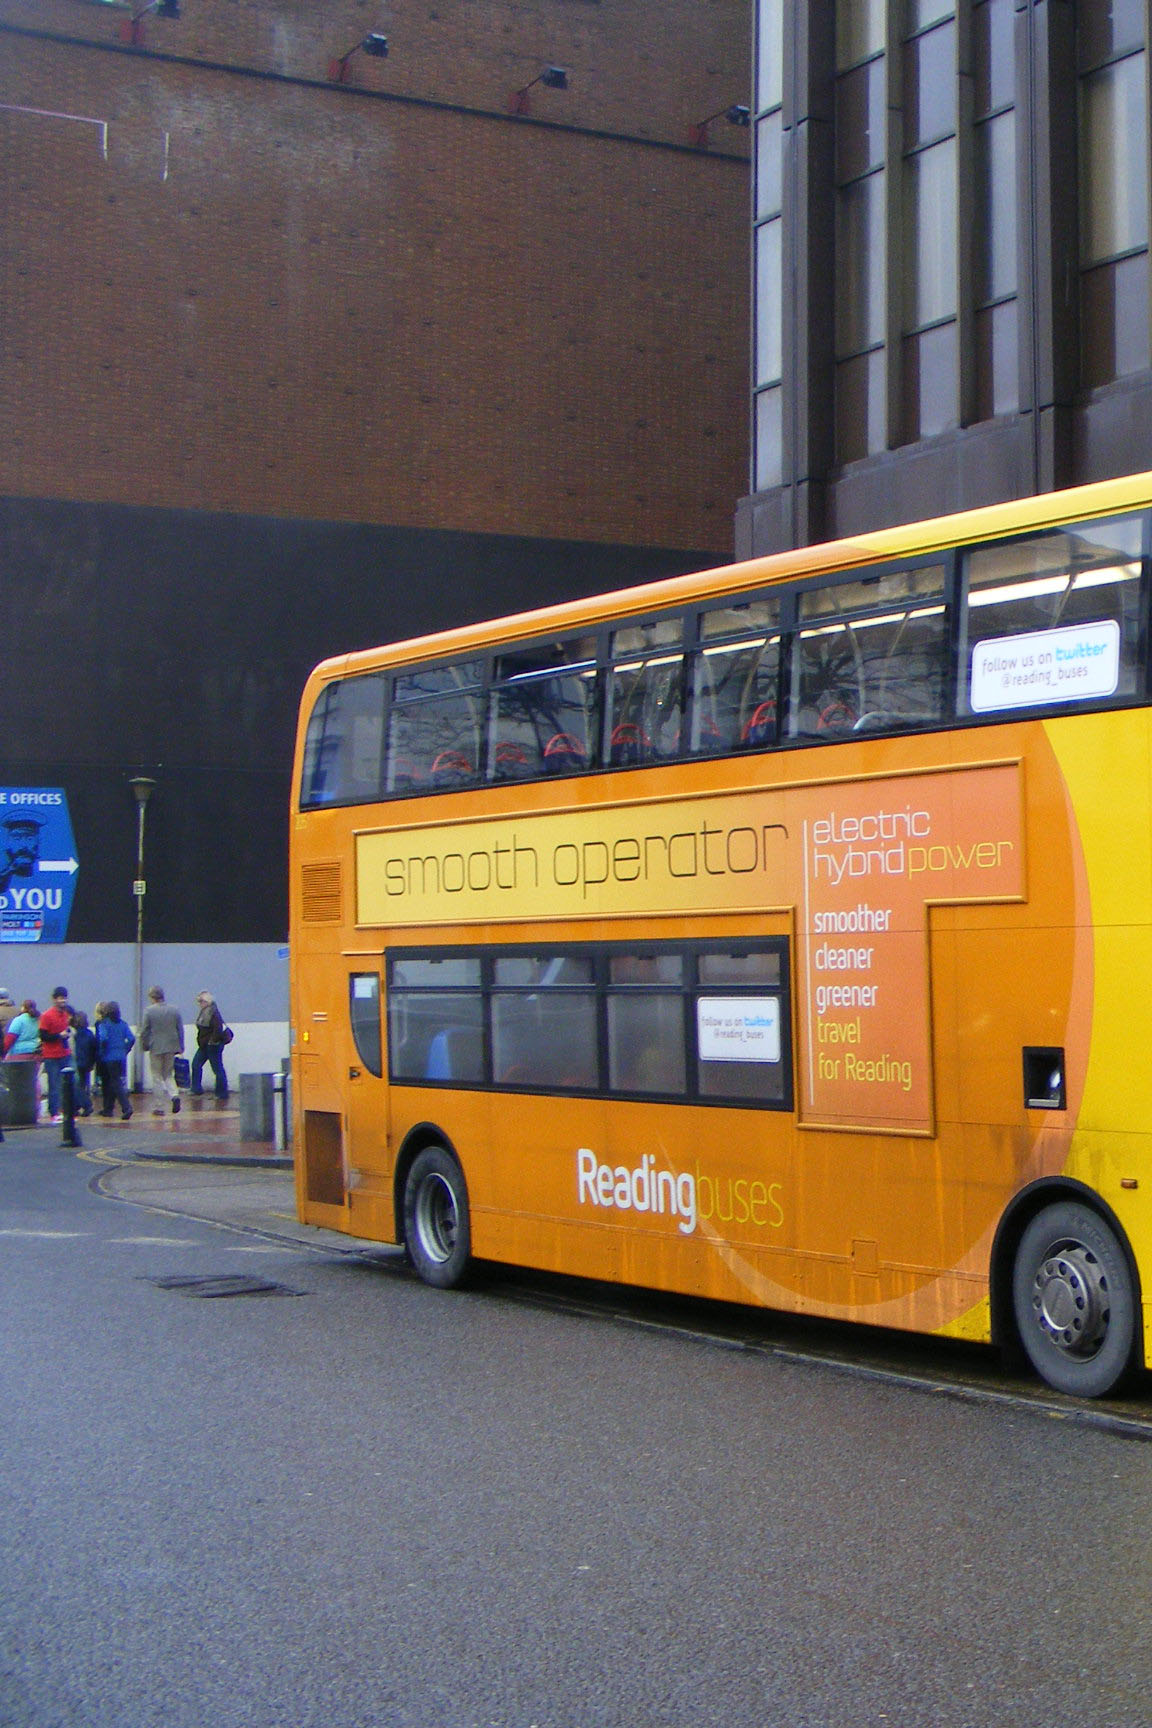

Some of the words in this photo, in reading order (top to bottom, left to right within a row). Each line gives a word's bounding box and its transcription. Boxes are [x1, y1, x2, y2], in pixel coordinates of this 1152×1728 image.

[981, 656, 1018, 676] follow
[1021, 655, 1034, 668] us
[1038, 652, 1053, 665] on
[1055, 642, 1108, 662] twitter
[10, 792, 63, 806] OFFICES
[812, 804, 931, 844] electric
[384, 833, 538, 897] smooth
[552, 819, 789, 900] operator
[813, 841, 905, 885] hybrid
[907, 841, 1014, 881] power
[9, 887, 63, 910] YOU
[814, 903, 892, 934] smoother
[815, 942, 875, 970] cleaner
[815, 983, 879, 1014] greener
[817, 1016, 861, 1044] travel
[818, 1052, 840, 1080] for
[845, 1053, 912, 1092] Reading
[577, 1147, 696, 1234] Reading
[695, 1159, 785, 1228] buses
